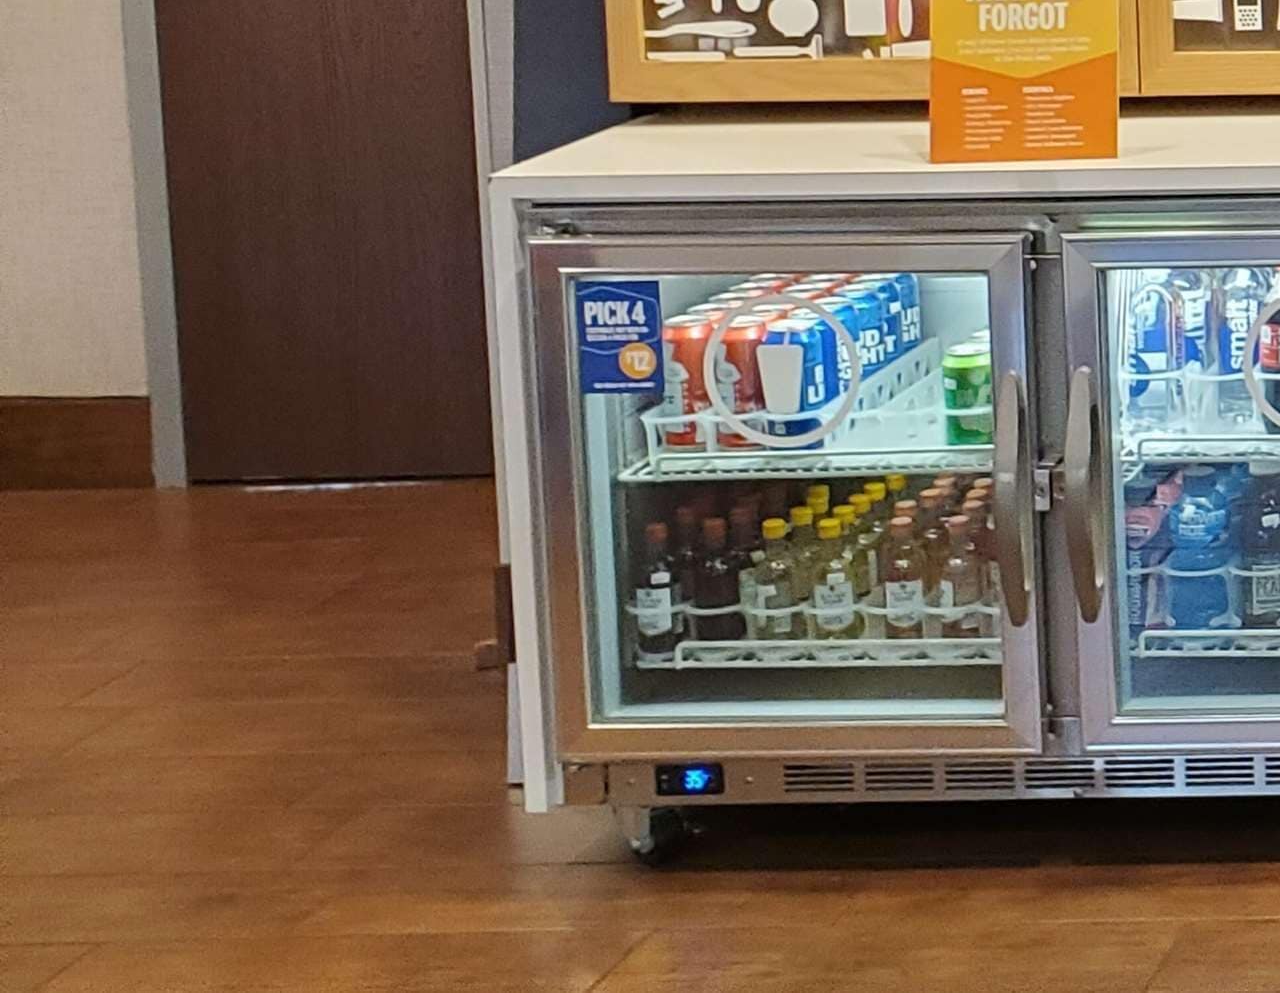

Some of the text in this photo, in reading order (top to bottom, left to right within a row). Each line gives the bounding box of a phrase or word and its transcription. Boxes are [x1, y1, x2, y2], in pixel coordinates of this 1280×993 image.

[978, 2, 1069, 32] FORGOT
[583, 300, 646, 325] PICK 4
